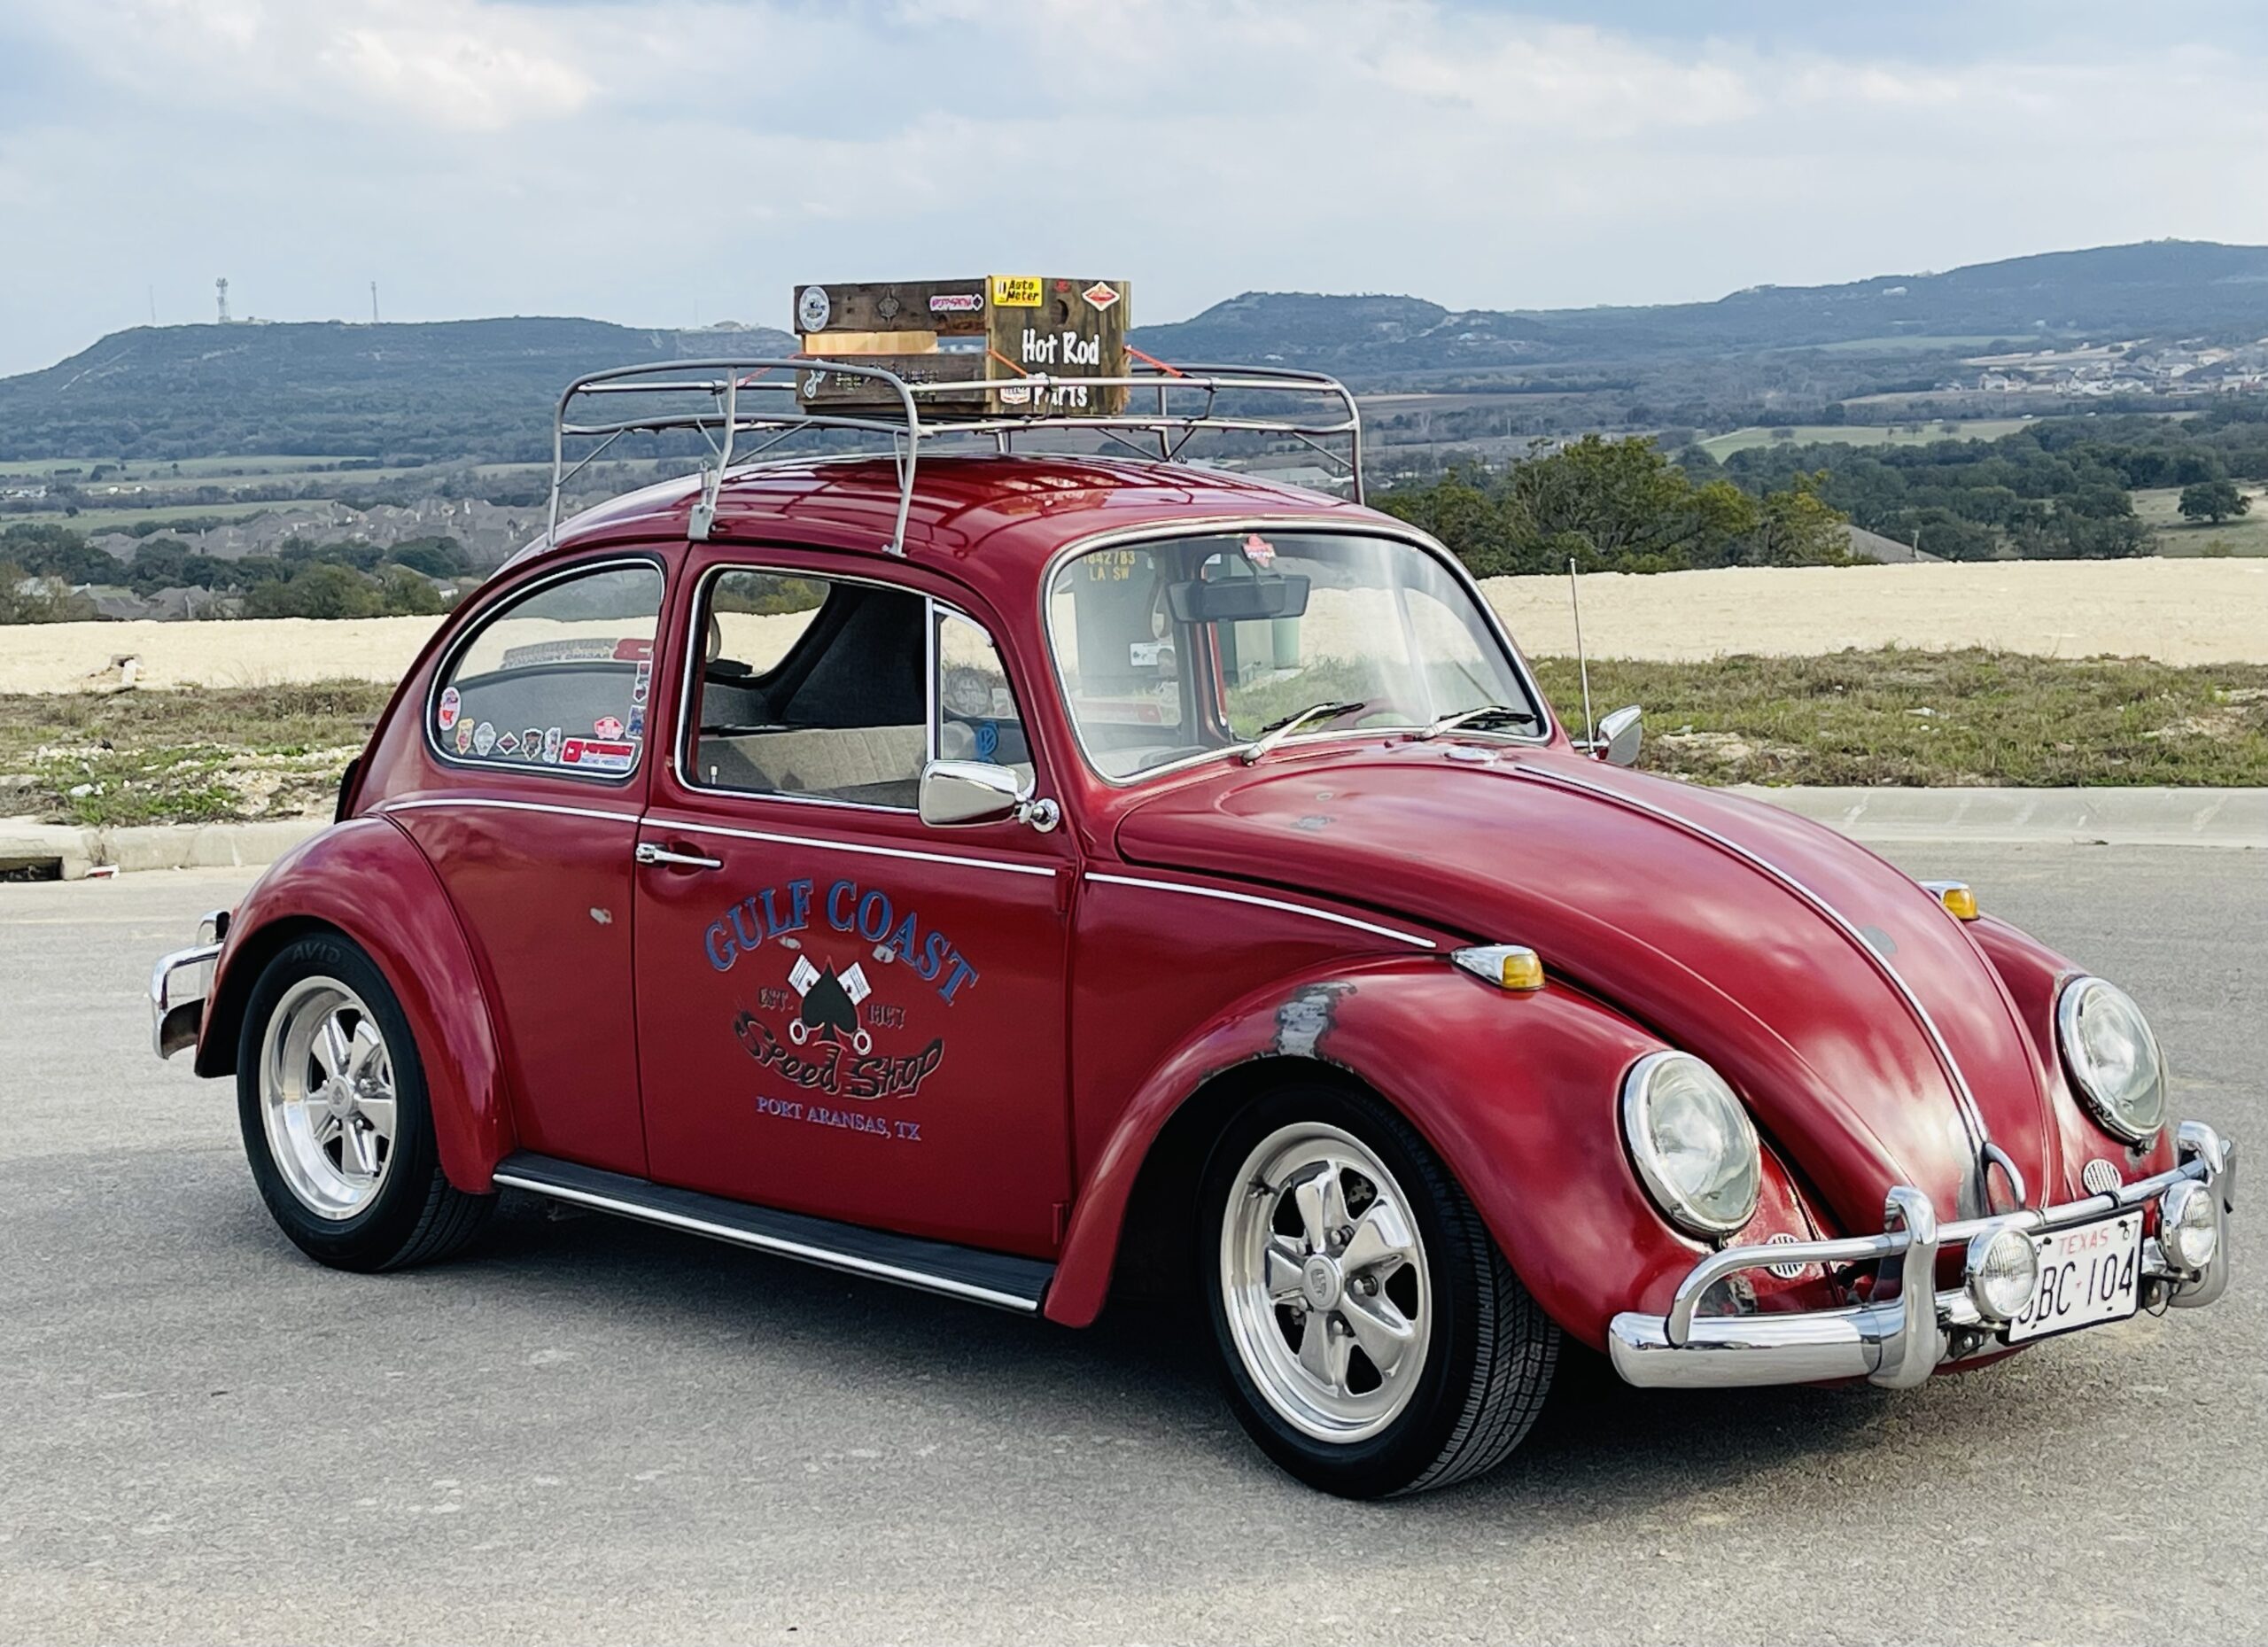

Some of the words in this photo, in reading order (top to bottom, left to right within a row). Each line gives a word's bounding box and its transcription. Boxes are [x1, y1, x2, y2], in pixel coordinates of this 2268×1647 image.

[1006, 291, 1039, 301] Meter
[1009, 280, 1034, 290] Auto
[1021, 328, 1059, 363] Hot
[1062, 331, 1100, 365] Rod
[1089, 567, 1106, 581] LA
[1113, 567, 1129, 581] SW
[291, 942, 341, 964] AVID
[704, 878, 813, 972] GULF
[827, 879, 979, 1006] COAST
[734, 1011, 842, 1095] Speed
[843, 1037, 944, 1099] Shop
[757, 1096, 804, 1120] PORT
[806, 1107, 892, 1139] ARANSAS,
[895, 1121, 922, 1141] TX
[2057, 1227, 2109, 1256] TEXAS
[2086, 1246, 2135, 1307] 104
